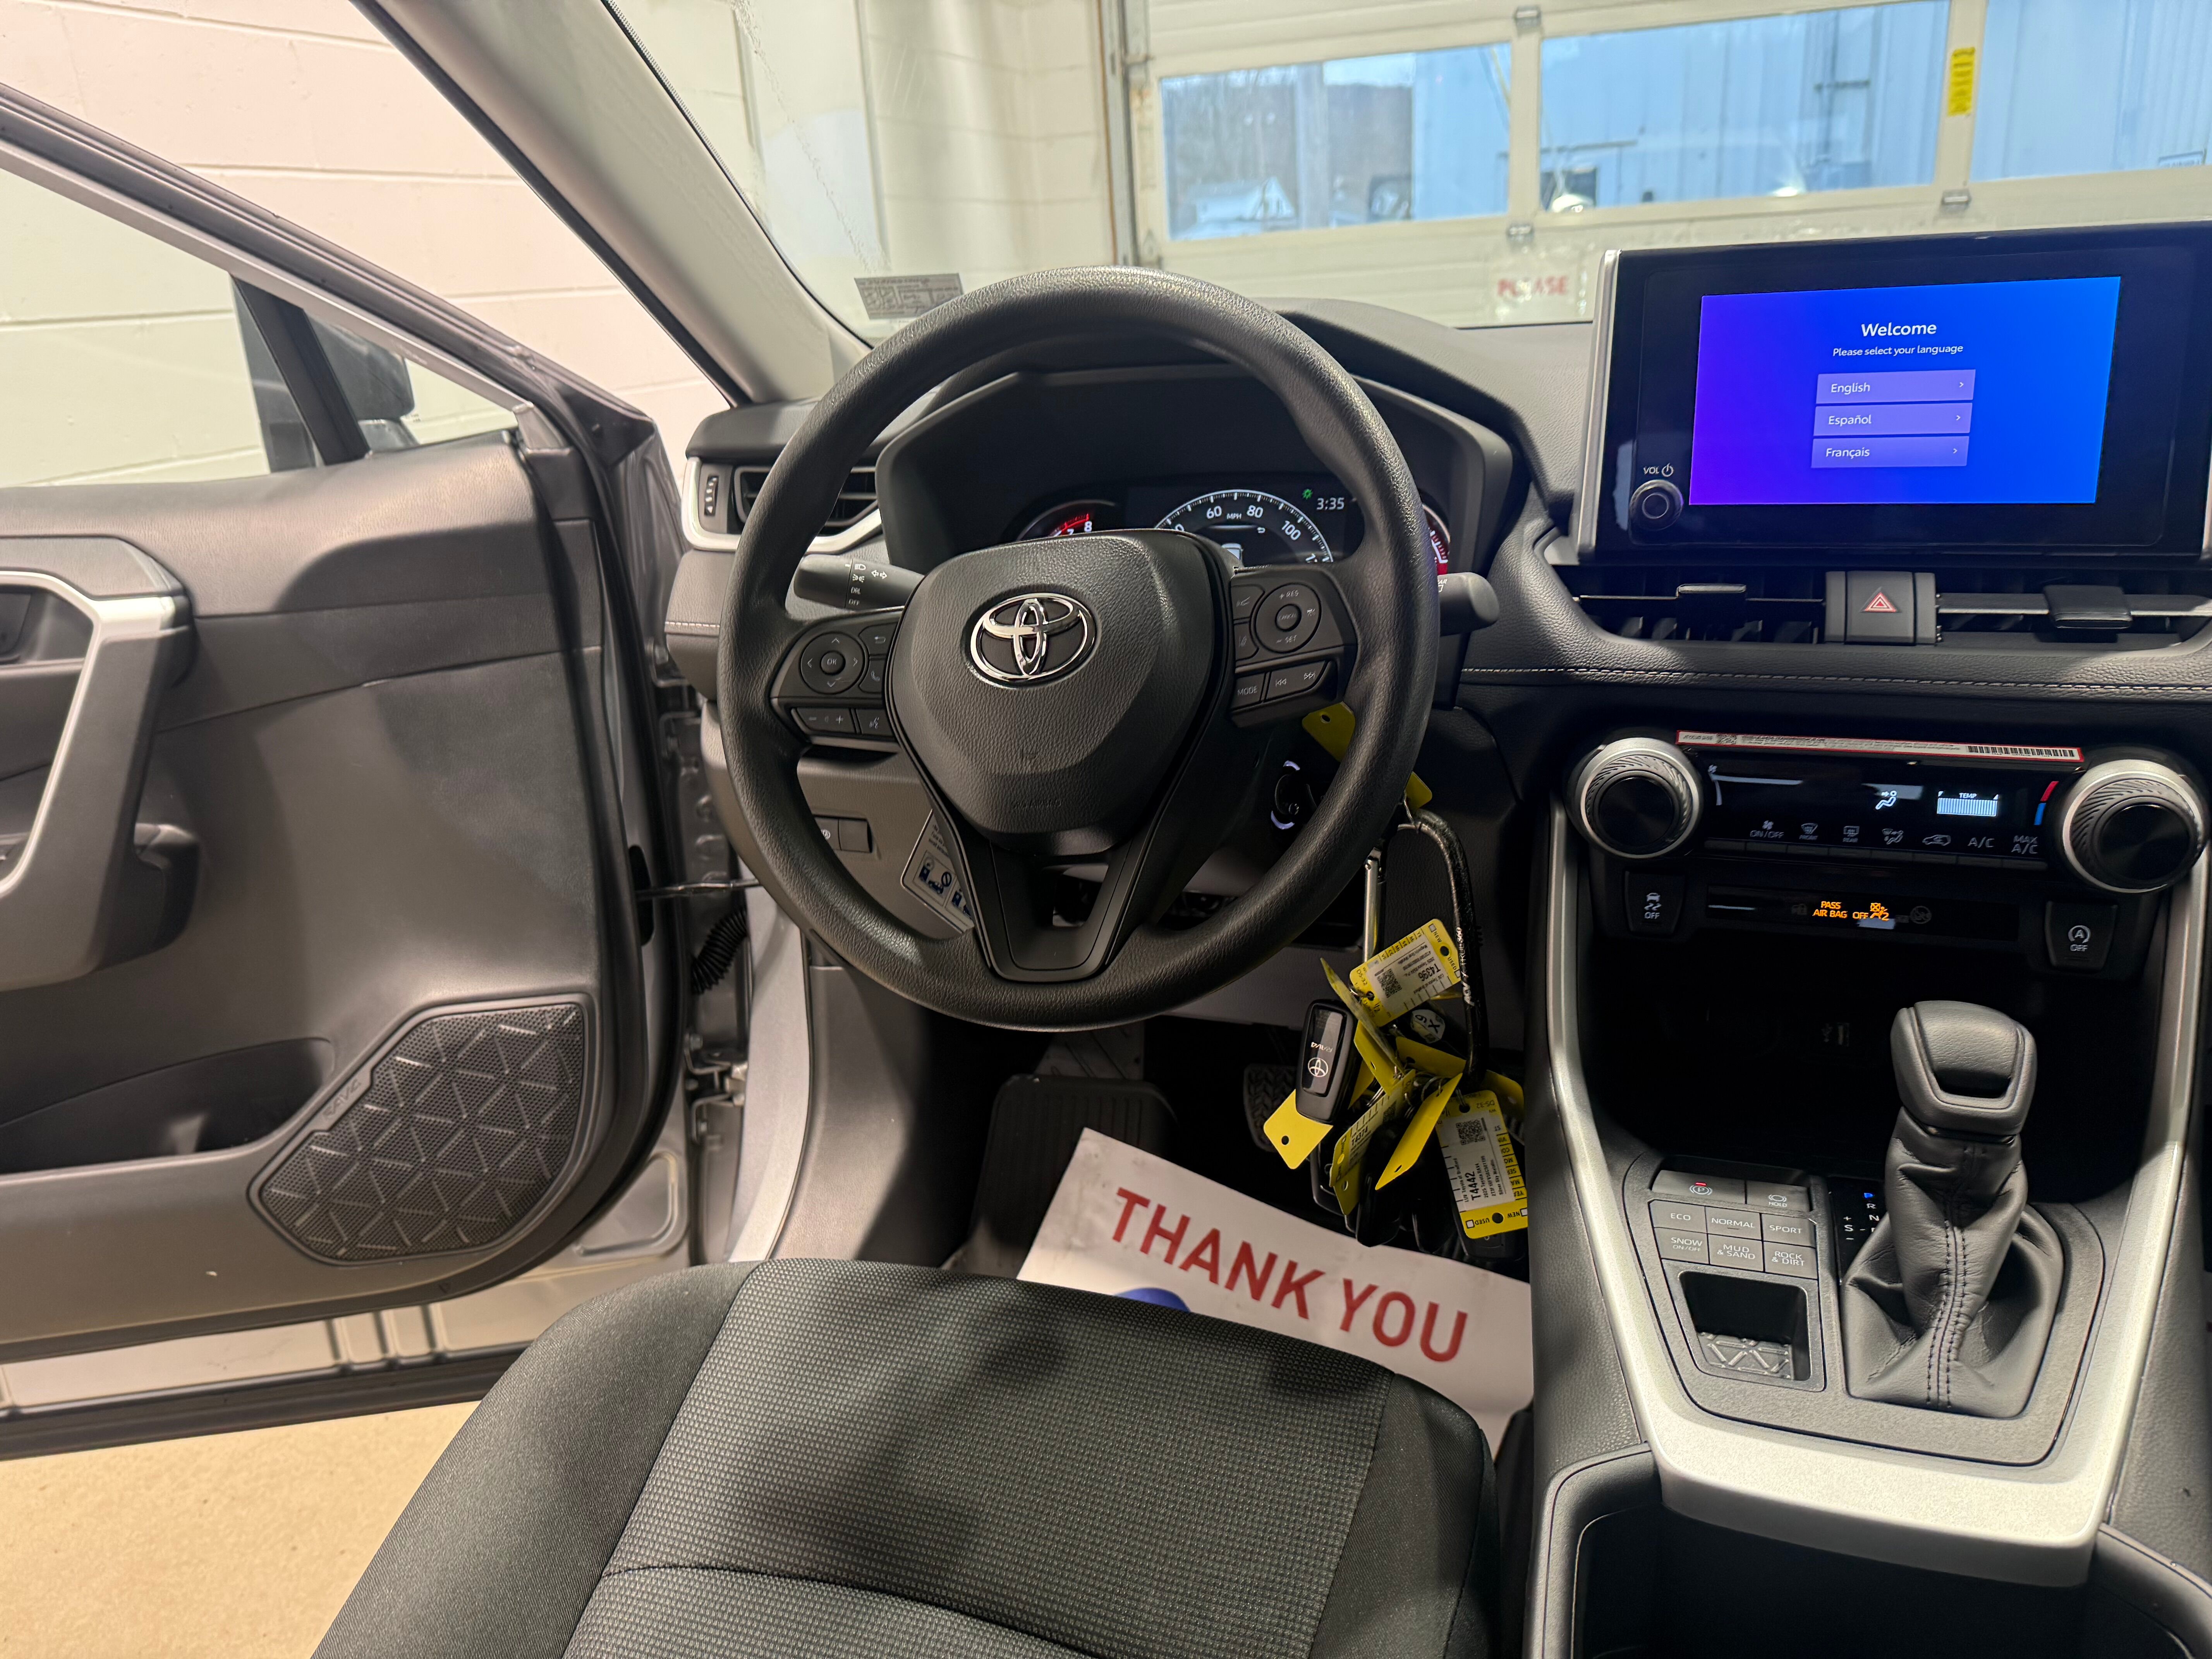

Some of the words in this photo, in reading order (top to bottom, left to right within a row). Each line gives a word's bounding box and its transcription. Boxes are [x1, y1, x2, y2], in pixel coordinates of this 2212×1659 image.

[1497, 275, 1568, 297] PLASE
[1861, 322, 1937, 337] Welcome
[1833, 348, 1862, 357] Please
[1865, 347, 1892, 356] select
[1893, 345, 1915, 356] your
[1917, 345, 1963, 355] language
[1831, 382, 1870, 395] English
[1828, 414, 1872, 427] Español
[1826, 447, 1870, 459] Français
[1643, 466, 1659, 475] VOL
[1317, 498, 1345, 510] 3:35
[1206, 506, 1222, 519] 60
[1247, 505, 1263, 518] 80
[1084, 521, 1092, 532] 8
[1281, 520, 1301, 541] 100
[851, 586, 861, 594] DRL
[1237, 686, 1258, 696] MODE
[1967, 836, 1995, 848] A/C
[2013, 835, 2038, 843] MAX
[2011, 843, 2038, 854] A/C
[1821, 901, 1841, 909] PASS
[1434, 931, 1442, 943] NEW
[1448, 957, 1457, 970] USED
[1418, 963, 1441, 981] T4396
[1311, 1042, 1333, 1053] RAV4
[1465, 1171, 1481, 1201] T4442
[1671, 1213, 1691, 1221] ECO
[1711, 1218, 1755, 1228] NORMAL
[1769, 1225, 1802, 1234] SPORT
[1671, 1237, 1702, 1247] SNOW
[1723, 1244, 1750, 1253] MUD
[1727, 1250, 1755, 1259] SAND
[1775, 1251, 1802, 1260] ROCK
[1782, 1258, 1805, 1266] DIRT
[1112, 1187, 1326, 1320] THANK
[1339, 1278, 1468, 1362] YOU
